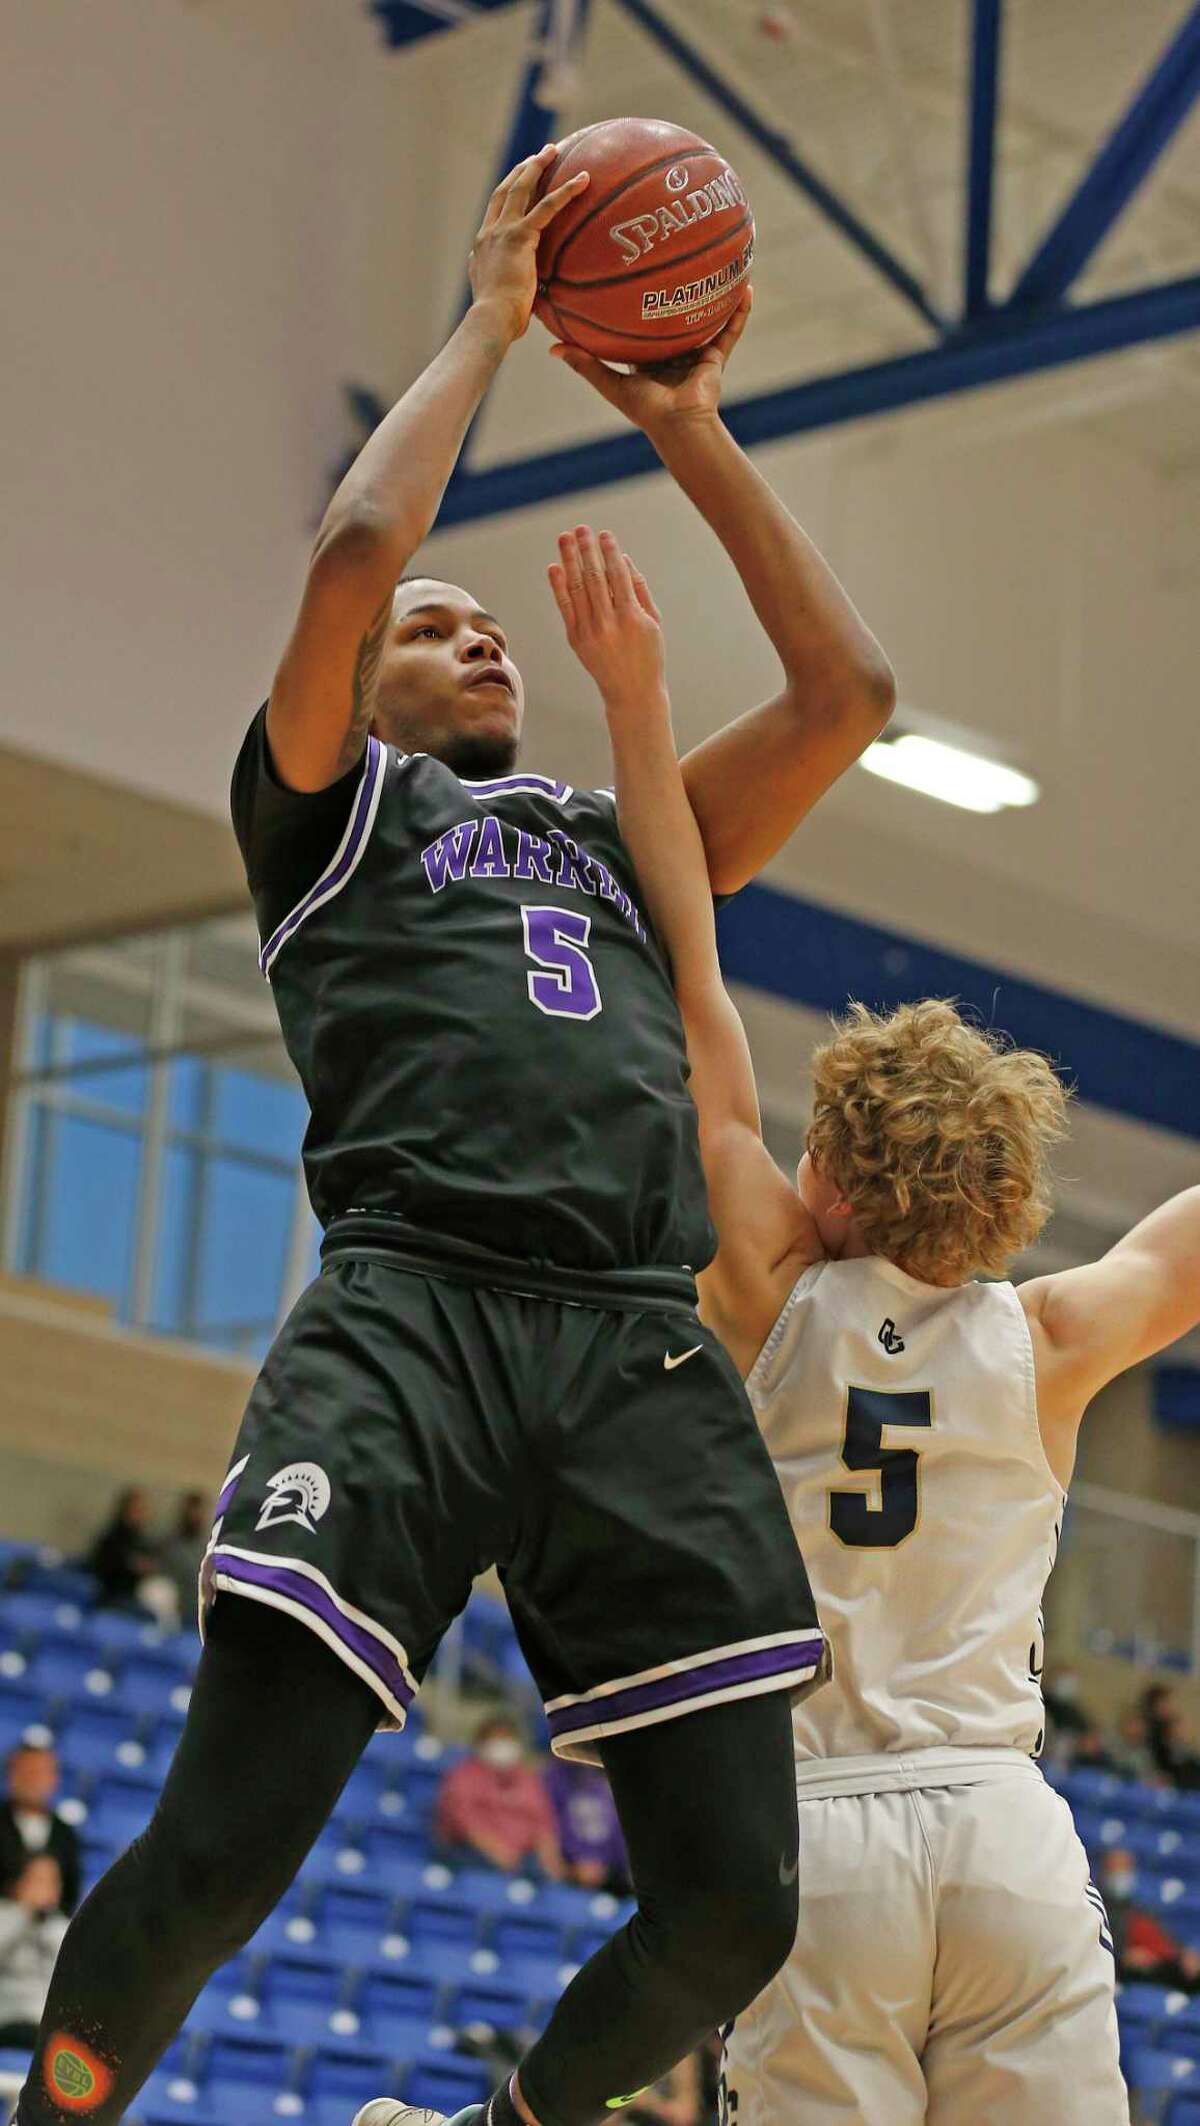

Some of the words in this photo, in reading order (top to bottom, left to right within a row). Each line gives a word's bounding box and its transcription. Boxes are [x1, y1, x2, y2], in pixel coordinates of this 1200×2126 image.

[641, 258, 741, 310] PLATINUM
[520, 905, 602, 1021] 5
[827, 1385, 936, 1552] 5
